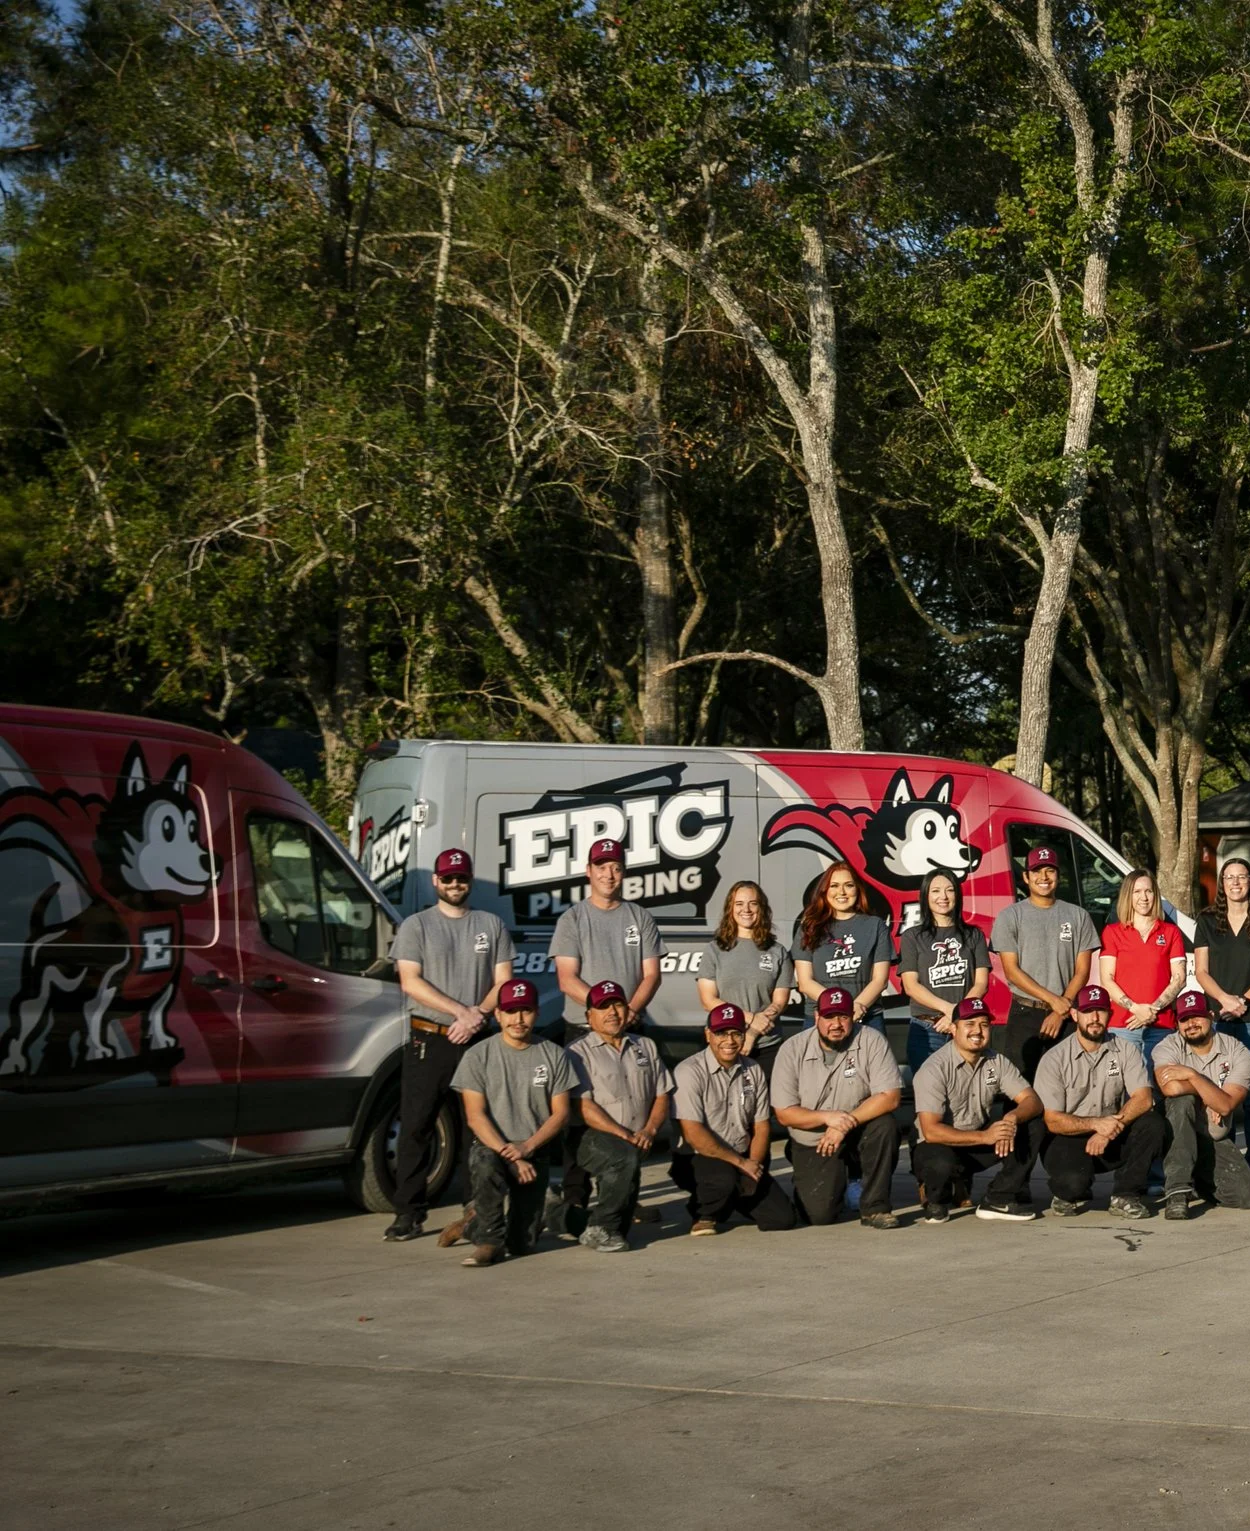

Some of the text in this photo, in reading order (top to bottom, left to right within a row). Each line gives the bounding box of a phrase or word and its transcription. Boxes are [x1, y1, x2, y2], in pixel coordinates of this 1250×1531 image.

[370, 821, 412, 880] EPIC
[505, 786, 727, 888] EPIC
[529, 866, 702, 918] PLUBING
[142, 929, 170, 968] E
[825, 956, 861, 973] EPIC
[931, 962, 965, 980] EPIC
